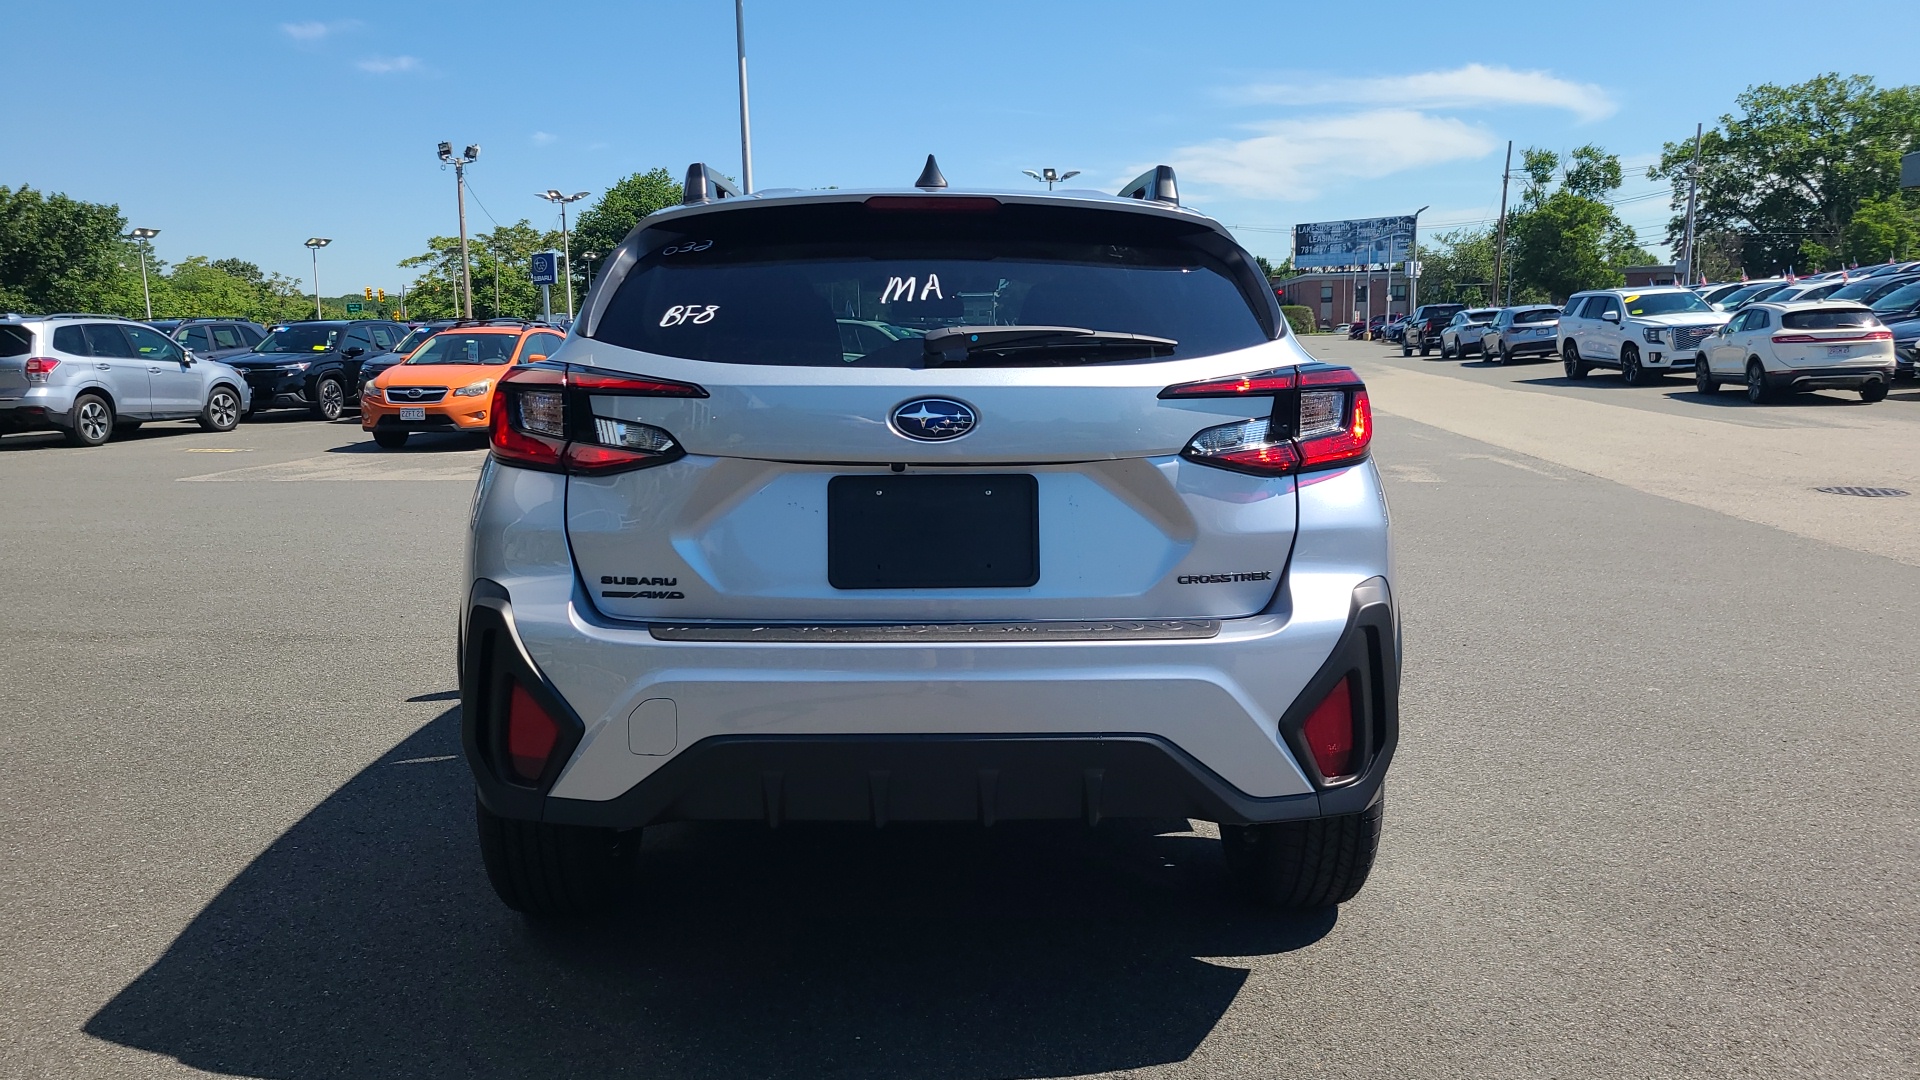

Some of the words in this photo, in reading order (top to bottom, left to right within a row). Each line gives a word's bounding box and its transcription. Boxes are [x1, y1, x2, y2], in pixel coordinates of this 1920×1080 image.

[663, 240, 713, 255] 032
[533, 274, 552, 282] SUBARU
[881, 273, 943, 304] MA
[660, 305, 720, 327] BF8
[600, 576, 677, 586] SUBARU
[1177, 571, 1272, 584] CROSSTREK
[632, 591, 685, 599] AWD
